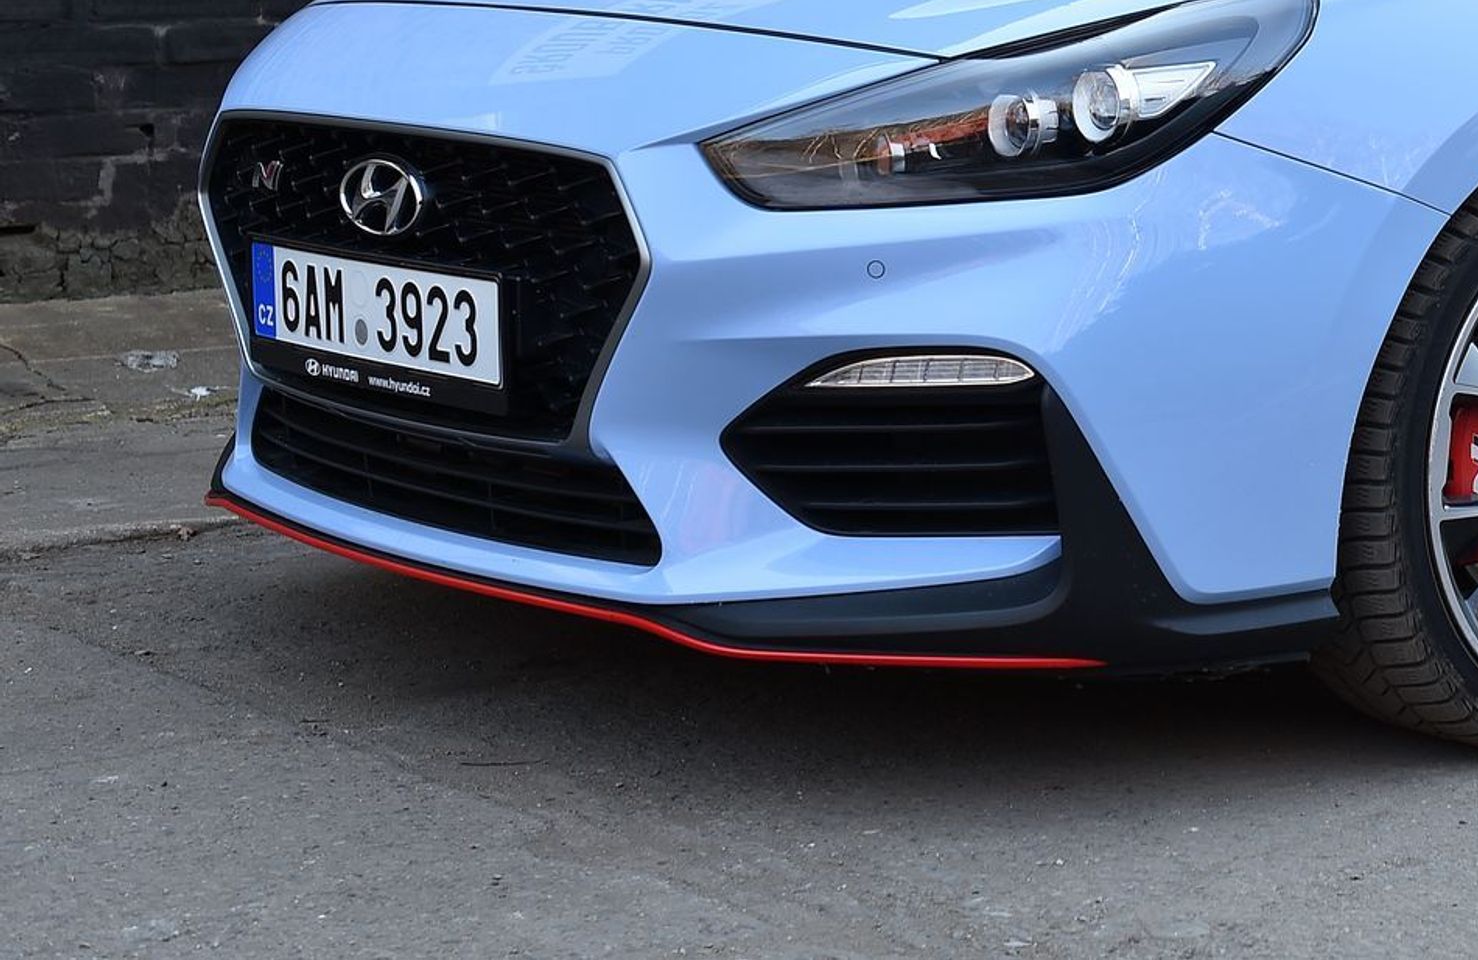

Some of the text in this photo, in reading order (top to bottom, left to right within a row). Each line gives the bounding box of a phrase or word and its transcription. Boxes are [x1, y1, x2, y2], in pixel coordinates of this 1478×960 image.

[258, 303, 274, 327] CZ
[281, 259, 478, 367] 6AM 3923
[321, 363, 360, 383] HYUNDAI
[367, 375, 431, 397] www.hyundai.cz
